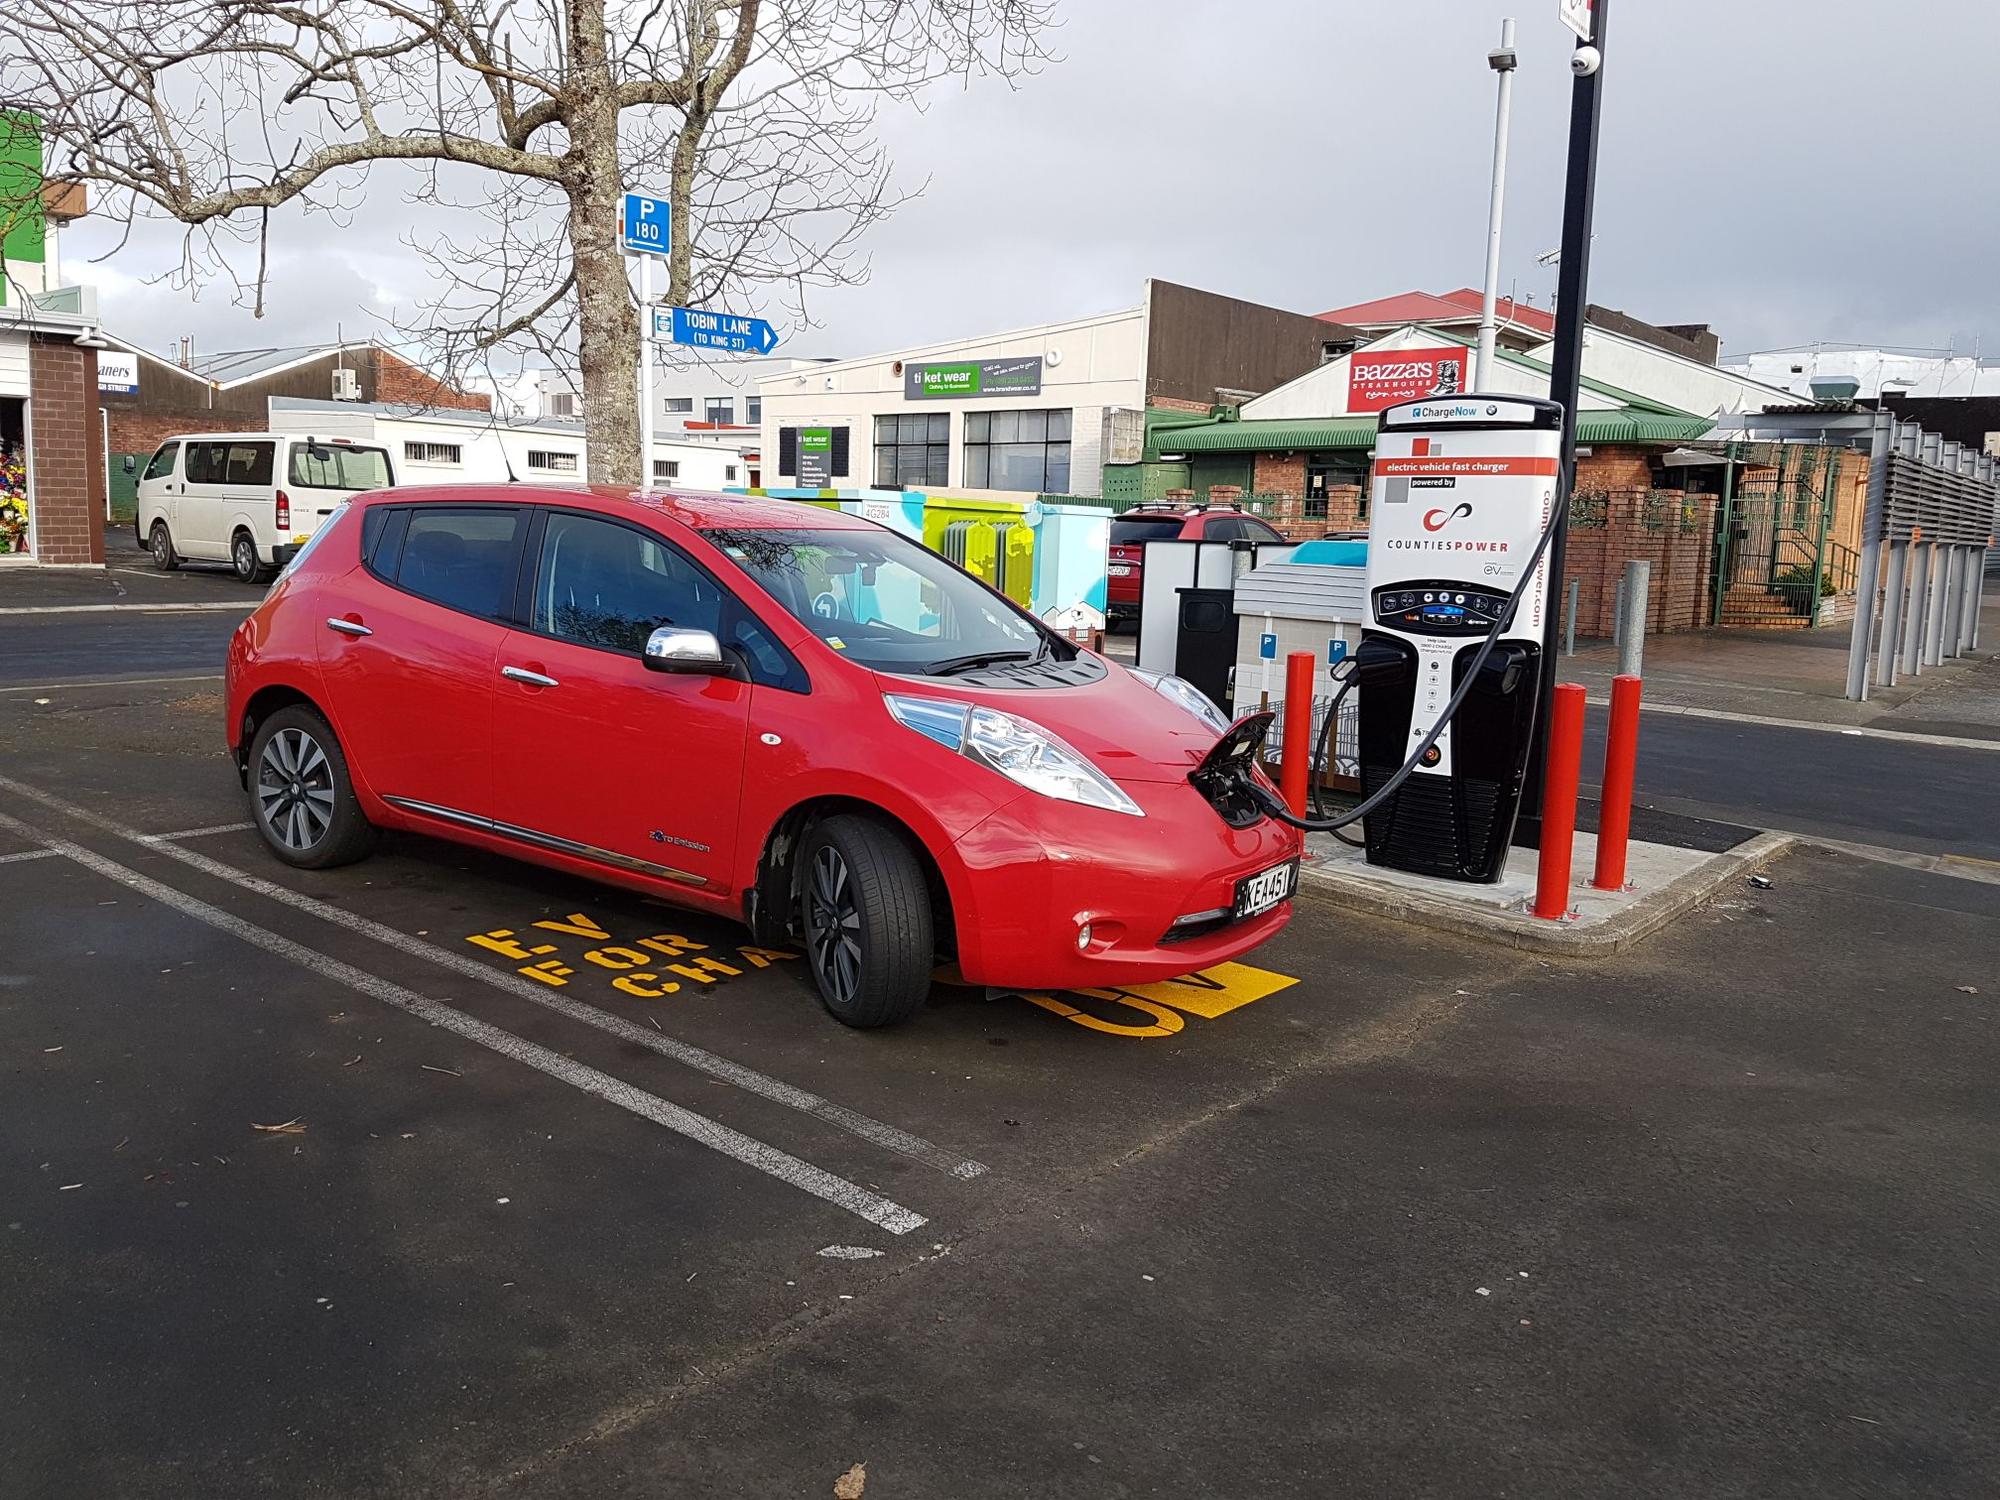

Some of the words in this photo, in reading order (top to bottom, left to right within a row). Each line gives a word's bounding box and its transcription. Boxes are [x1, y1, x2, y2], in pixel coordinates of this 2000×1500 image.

[640, 199, 655, 220] P
[635, 221, 659, 240] 180
[685, 311, 718, 331] TOBIN
[723, 319, 752, 336] LANE
[693, 333, 707, 345] (TO
[711, 335, 729, 347] KING
[731, 337, 745, 350] ST)
[98, 365, 131, 378] aners
[943, 371, 971, 383] wear
[107, 384, 130, 393] STREET
[1352, 380, 1432, 390] STEAKHOUSE
[1421, 406, 1478, 418] ChargeNow
[1387, 462, 1418, 472] electric
[1419, 462, 1451, 471] vehicle
[1452, 462, 1470, 471] fast
[1471, 462, 1509, 473] charger
[1411, 479, 1443, 487] powered
[1444, 479, 1454, 487] by
[866, 509, 890, 519] 4G284
[1264, 636, 1272, 645] P
[1334, 642, 1342, 651] P
[1245, 869, 1288, 911] KEA451
[465, 913, 612, 960] EV
[517, 934, 710, 987] FOR
